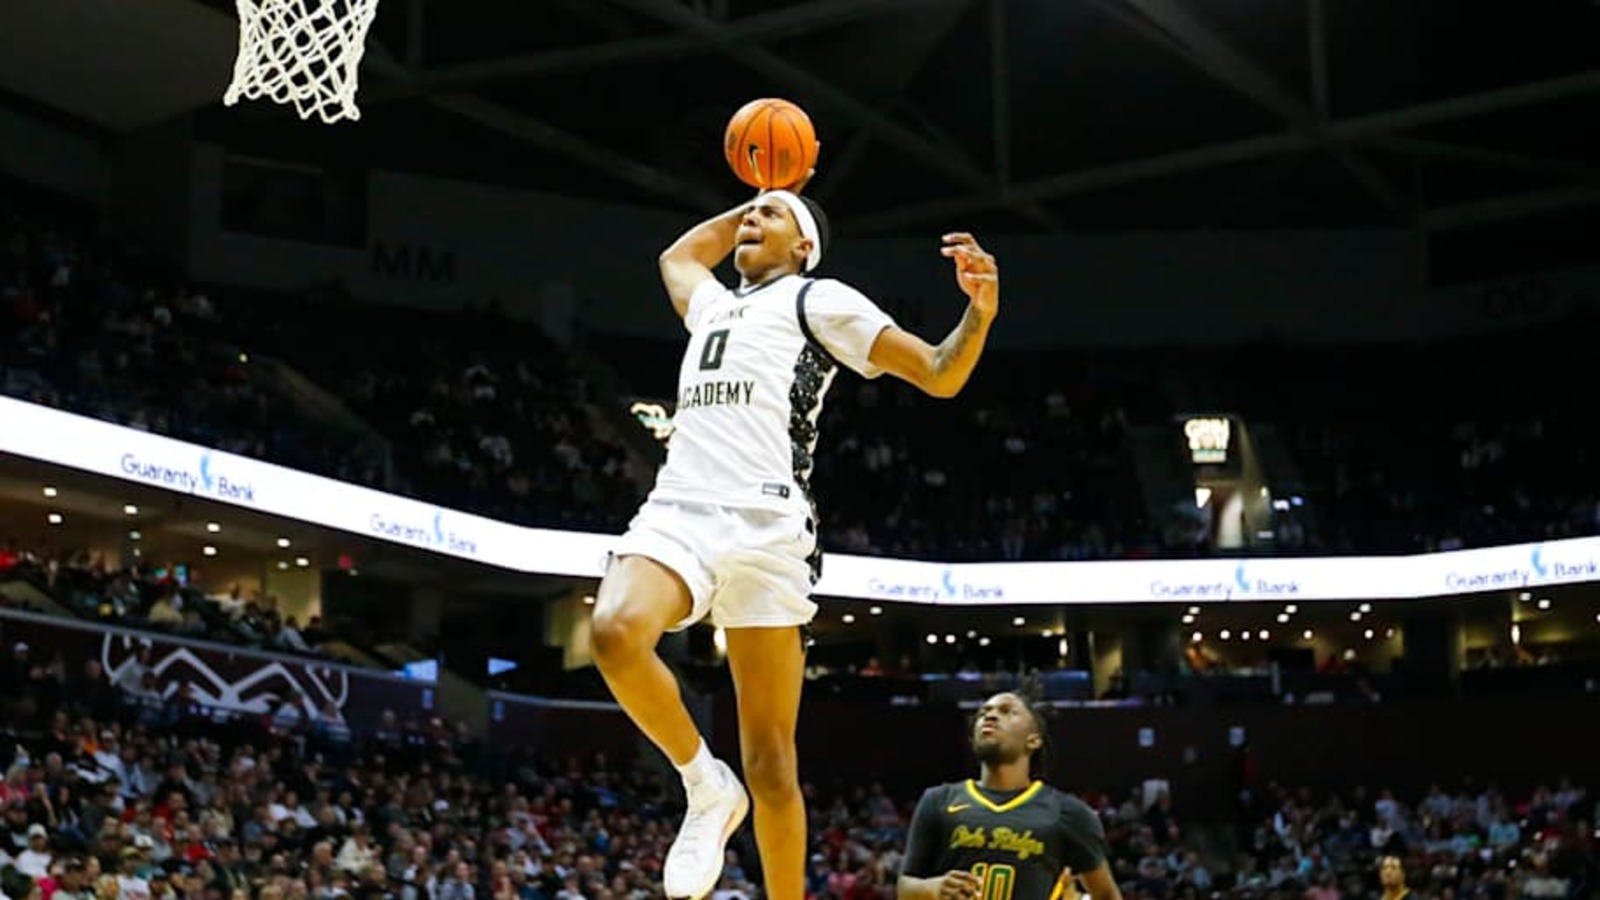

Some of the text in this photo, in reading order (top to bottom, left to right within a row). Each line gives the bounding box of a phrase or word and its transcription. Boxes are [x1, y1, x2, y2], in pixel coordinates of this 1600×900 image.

[372, 240, 456, 282] MM
[699, 329, 730, 371] 0
[676, 380, 754, 410] CADEMY
[121, 452, 254, 501] Guaranty Bank
[1150, 579, 1233, 600] Guaranty
[1445, 560, 1597, 590] Guaranty Bank
